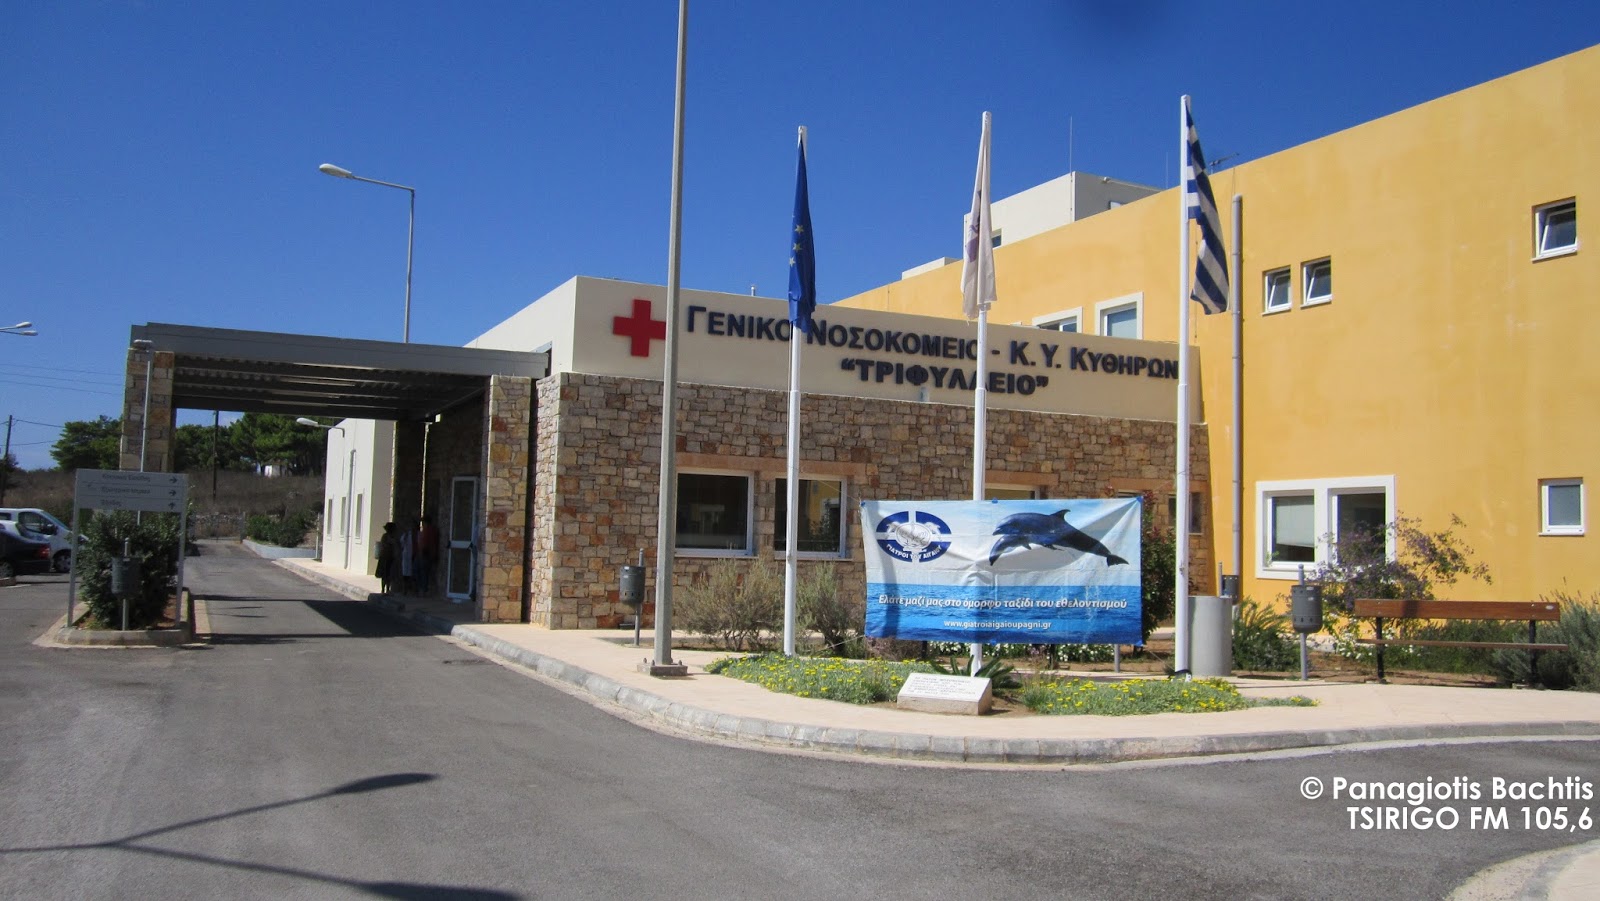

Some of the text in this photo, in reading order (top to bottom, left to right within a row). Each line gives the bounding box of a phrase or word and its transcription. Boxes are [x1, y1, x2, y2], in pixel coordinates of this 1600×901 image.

[687, 304, 793, 342] ΓΕΝΙΚΟ
[807, 318, 978, 361] ΝΟΣΟΚΟΜΕΙΟ
[1070, 346, 1179, 380] ΚΥΘΗΡΩΝ
[886, 543, 909, 559] ΓΙΑΤΡΟΙ
[878, 594, 1127, 610] Ελάτε μαζί μας στο όμορφο ταξίδι του εθελοντισμού
[943, 620, 1052, 630] www.giatroiaigaioupagni.gr
